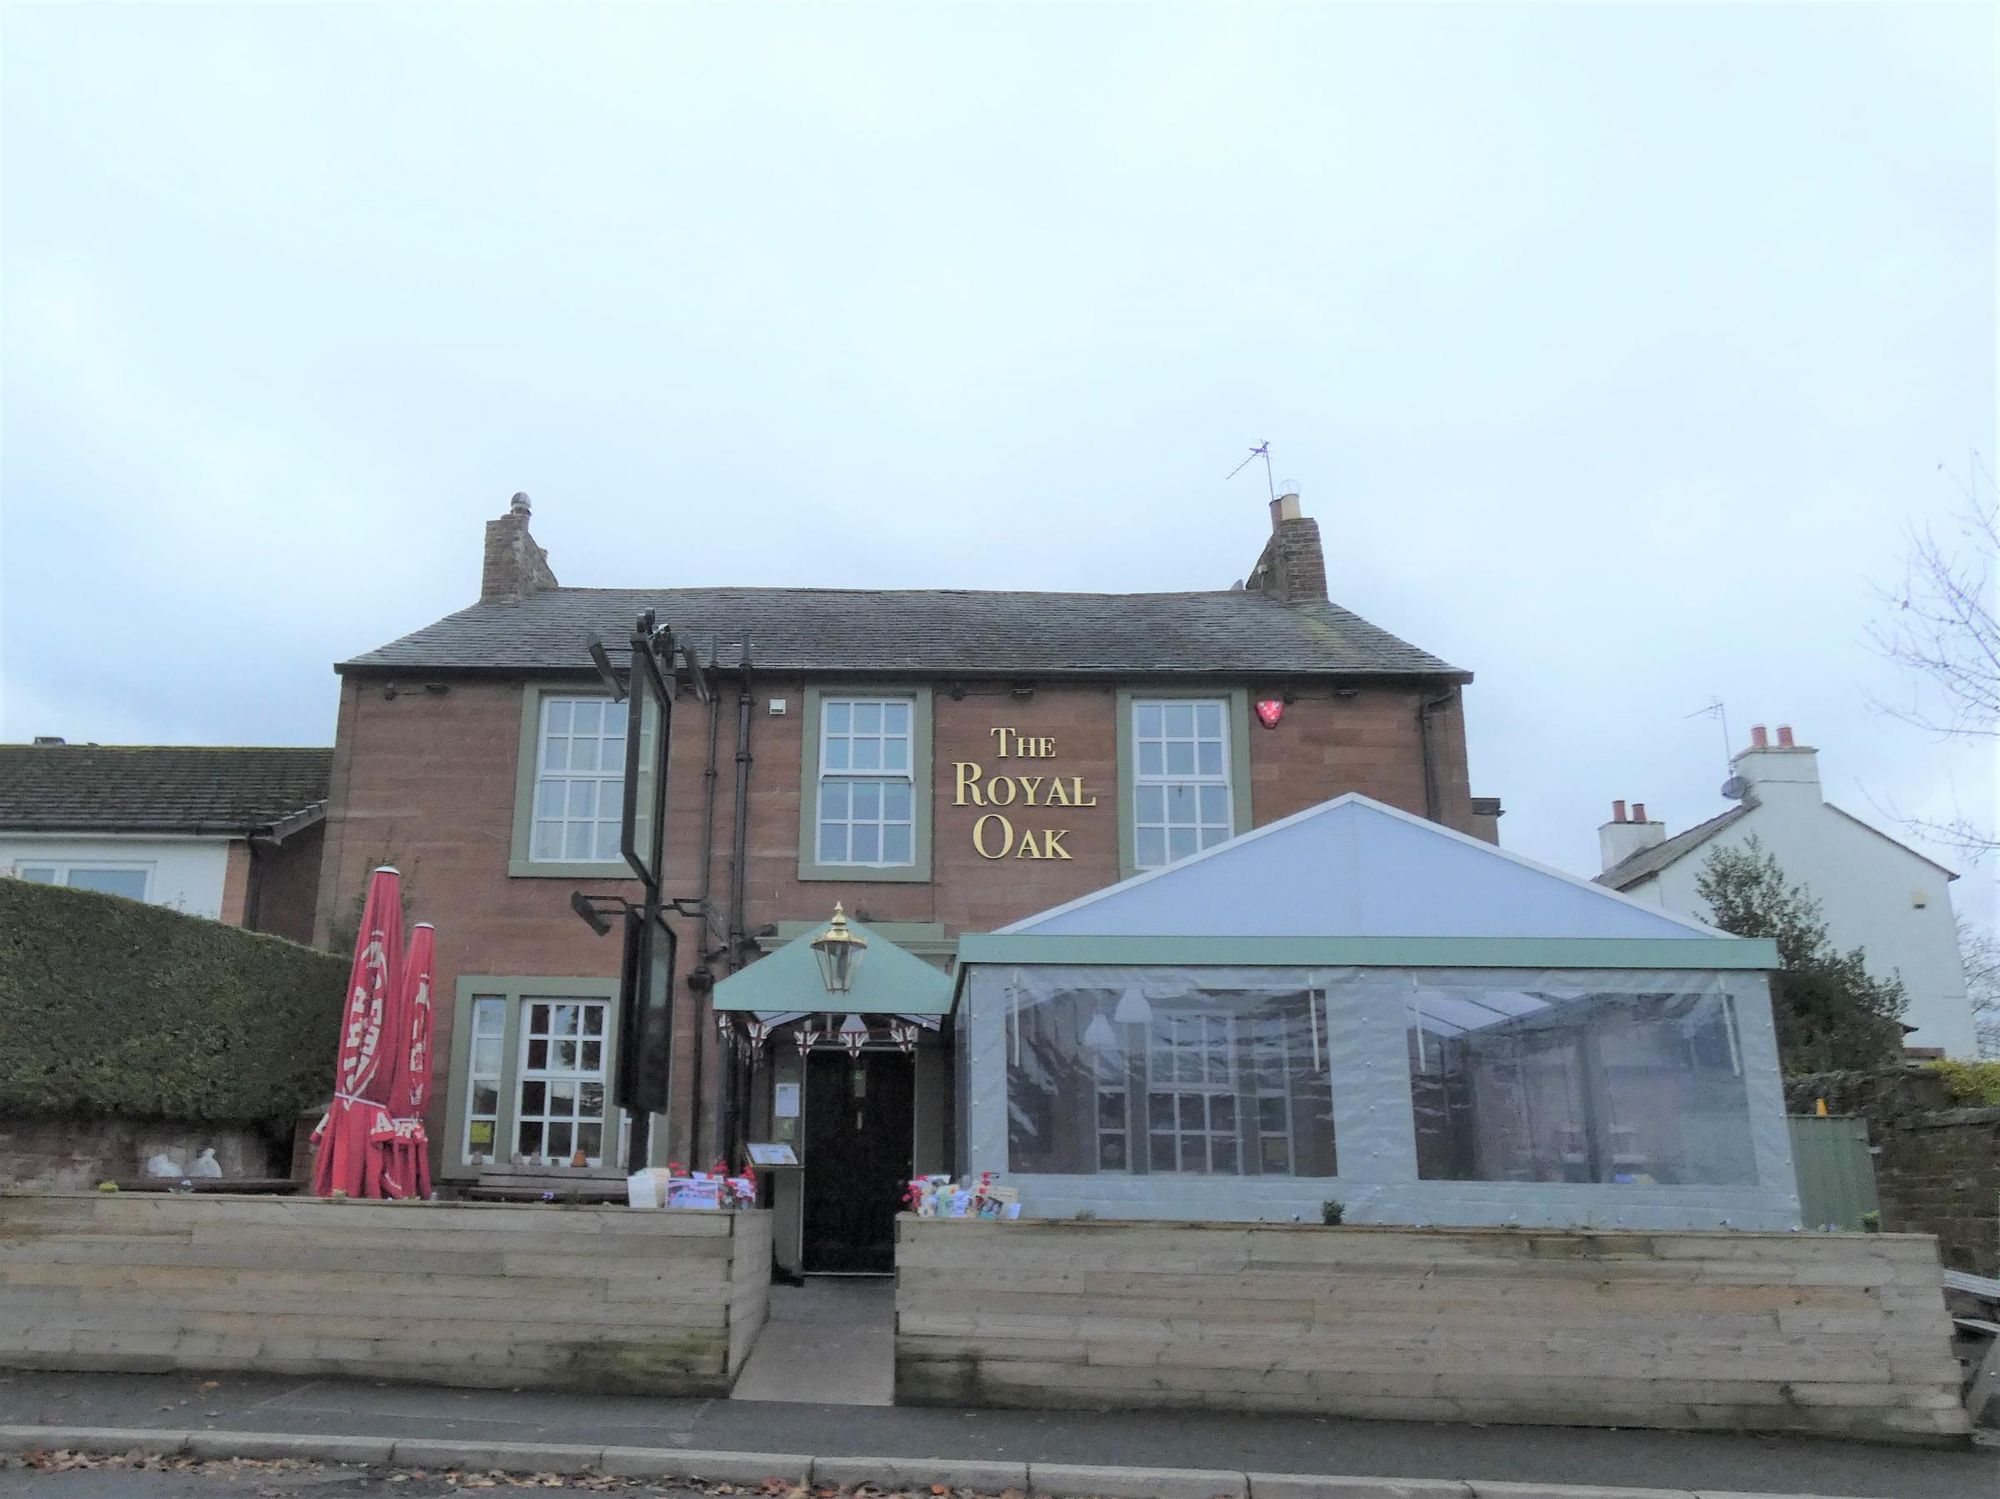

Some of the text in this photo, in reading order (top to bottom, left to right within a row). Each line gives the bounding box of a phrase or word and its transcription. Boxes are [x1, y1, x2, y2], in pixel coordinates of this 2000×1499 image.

[990, 727, 1056, 758] THE
[951, 762, 1097, 807] ROYAL
[972, 813, 1073, 860] OAK
